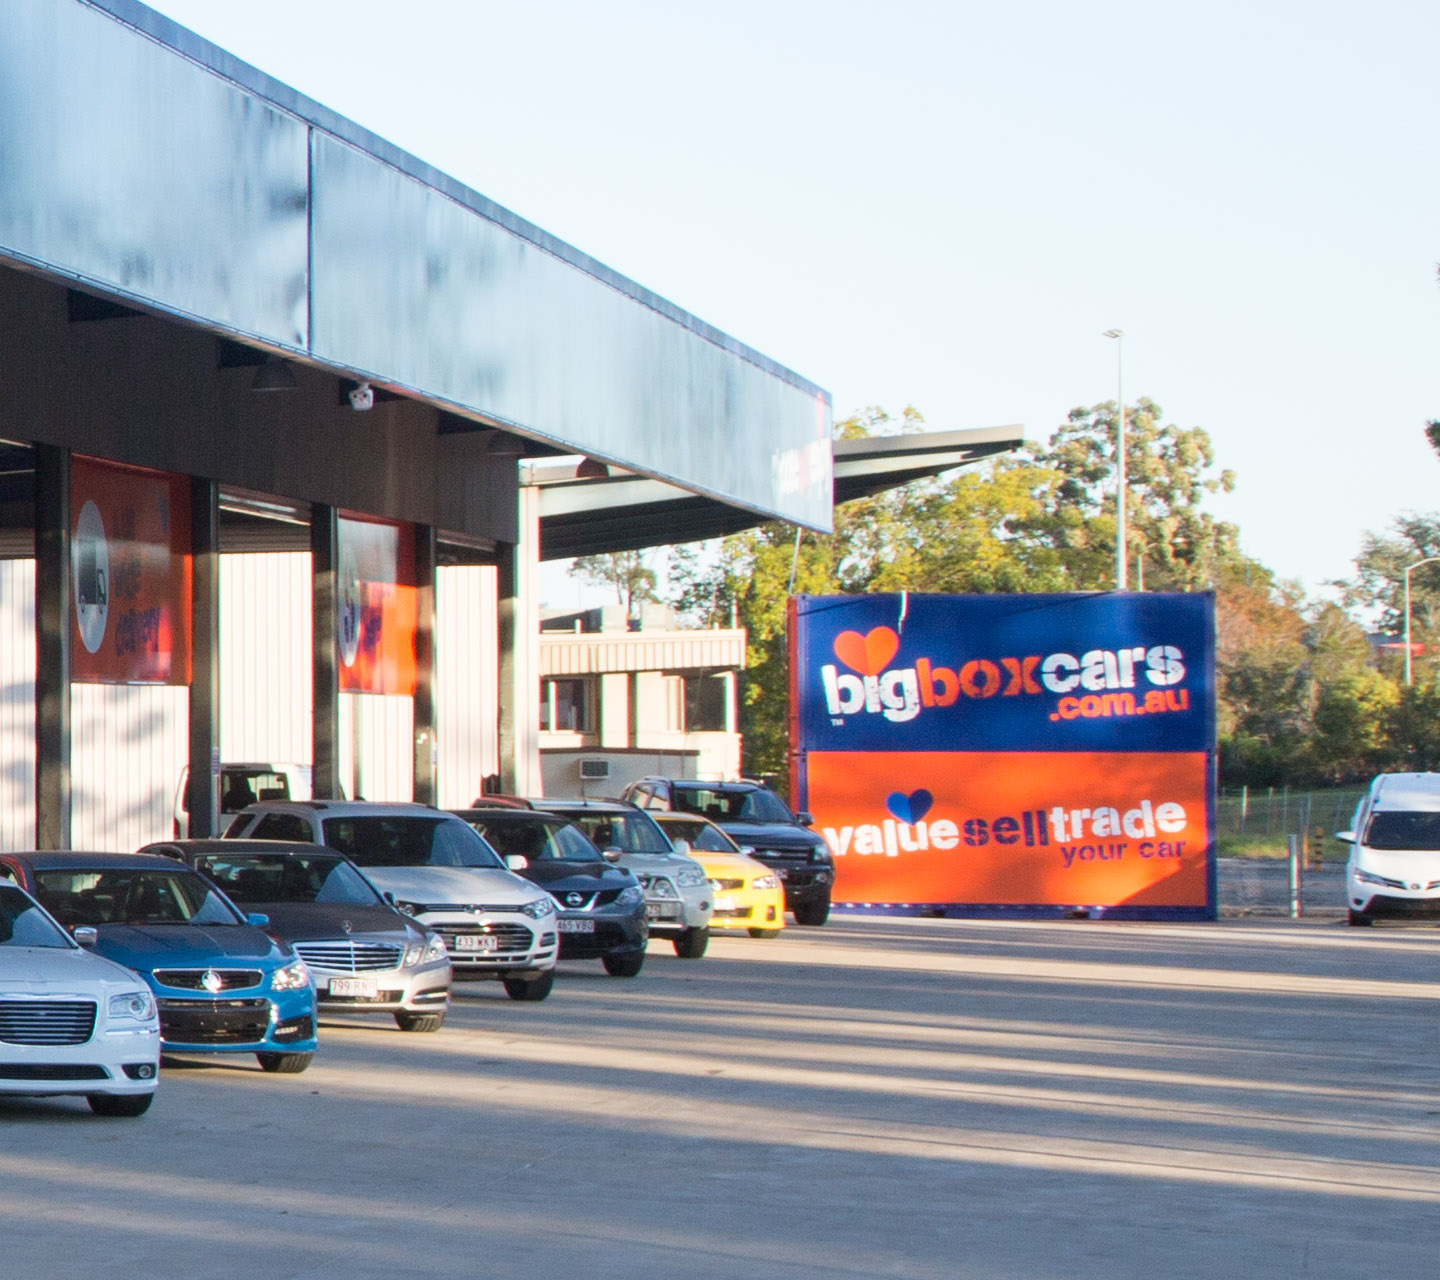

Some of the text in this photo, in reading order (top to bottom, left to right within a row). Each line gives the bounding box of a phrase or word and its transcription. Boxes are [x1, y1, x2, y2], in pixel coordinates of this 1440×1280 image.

[1049, 689, 1189, 721] .com.au
[1060, 839, 1187, 868] your car
